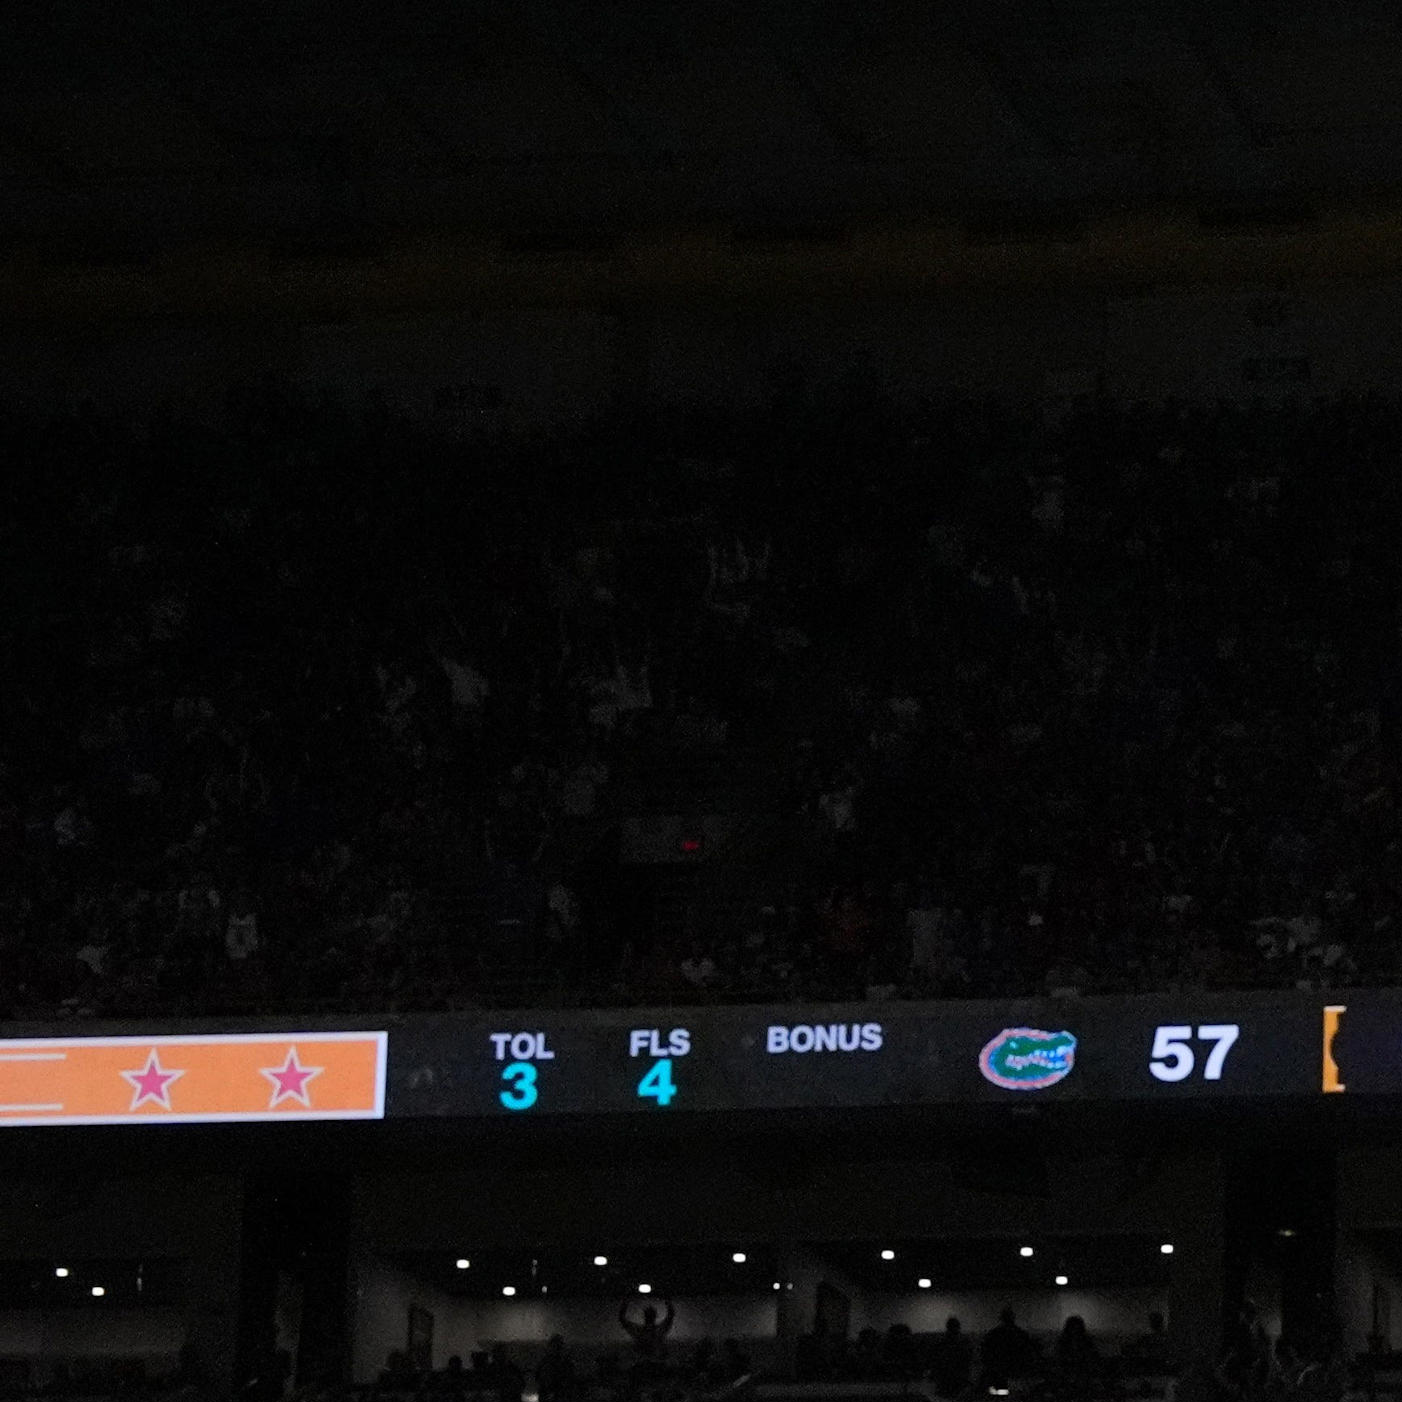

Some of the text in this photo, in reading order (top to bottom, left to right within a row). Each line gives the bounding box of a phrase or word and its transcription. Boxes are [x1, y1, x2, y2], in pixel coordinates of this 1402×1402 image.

[490, 1032, 555, 1061] TOL
[630, 1028, 691, 1057] FLS
[767, 1023, 883, 1053] BONUS
[1149, 1024, 1240, 1083] 57
[500, 1062, 538, 1111] 3
[637, 1060, 677, 1105] 4
